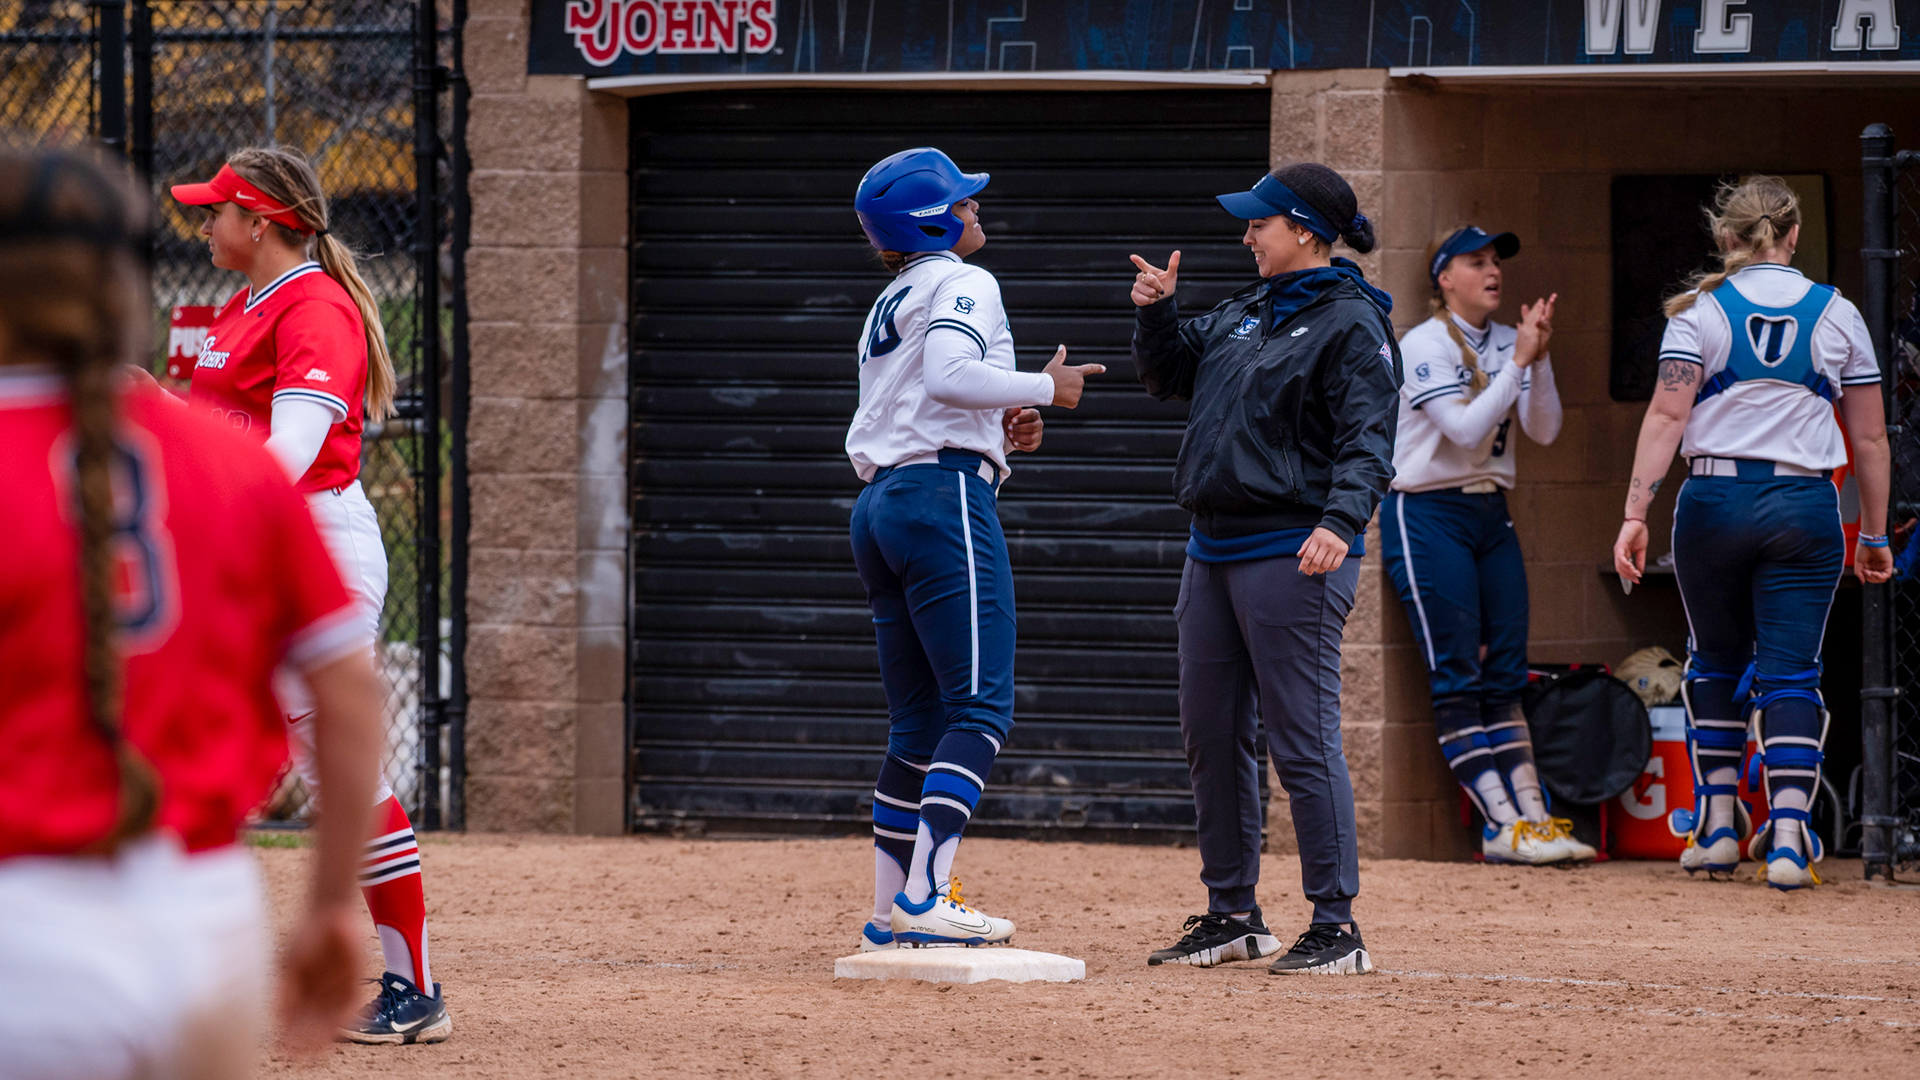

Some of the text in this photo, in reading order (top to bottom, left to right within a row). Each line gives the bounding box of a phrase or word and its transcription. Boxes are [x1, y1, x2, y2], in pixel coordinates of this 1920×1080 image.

[919, 207, 944, 216] EASTON
[169, 327, 209, 358] PUS
[1619, 756, 1667, 821] G
